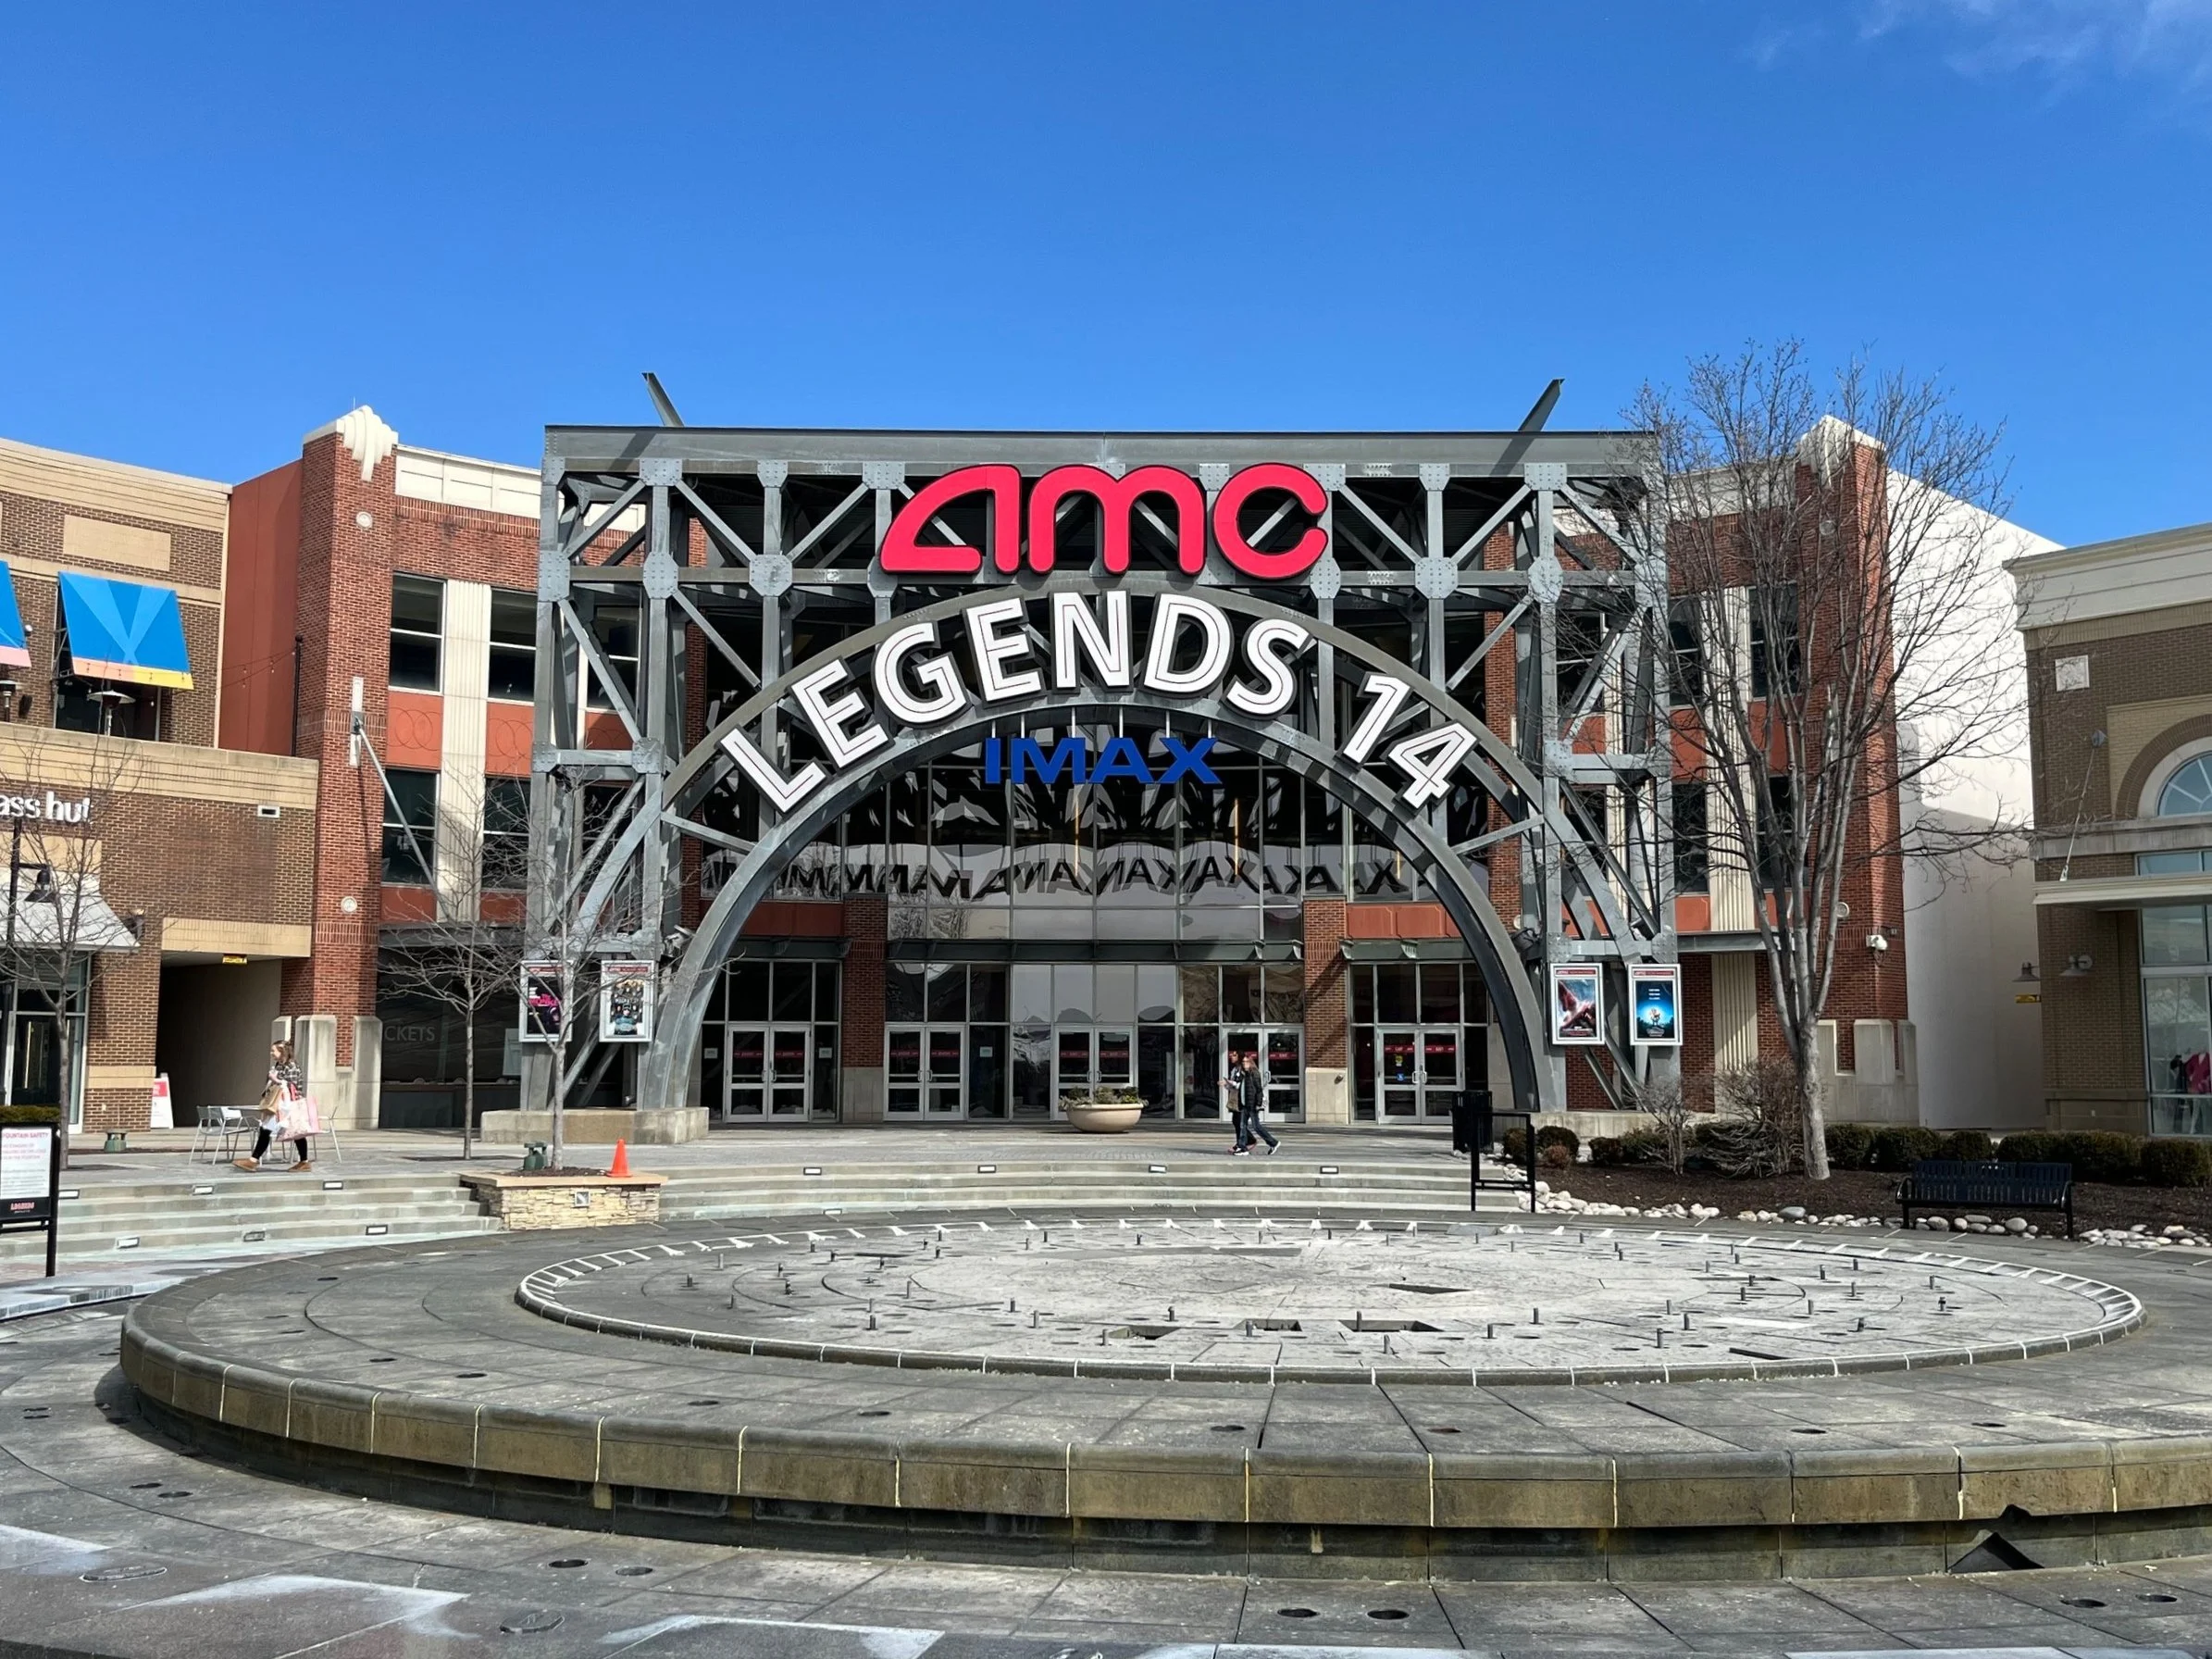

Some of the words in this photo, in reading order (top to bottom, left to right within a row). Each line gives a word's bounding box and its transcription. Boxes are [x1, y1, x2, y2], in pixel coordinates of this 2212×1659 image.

[878, 462, 1329, 580] amc
[719, 590, 1314, 815] LEGENDS
[1340, 672, 1479, 812] 14
[985, 736, 1224, 784] IMAX
[45, 791, 94, 825] hut
